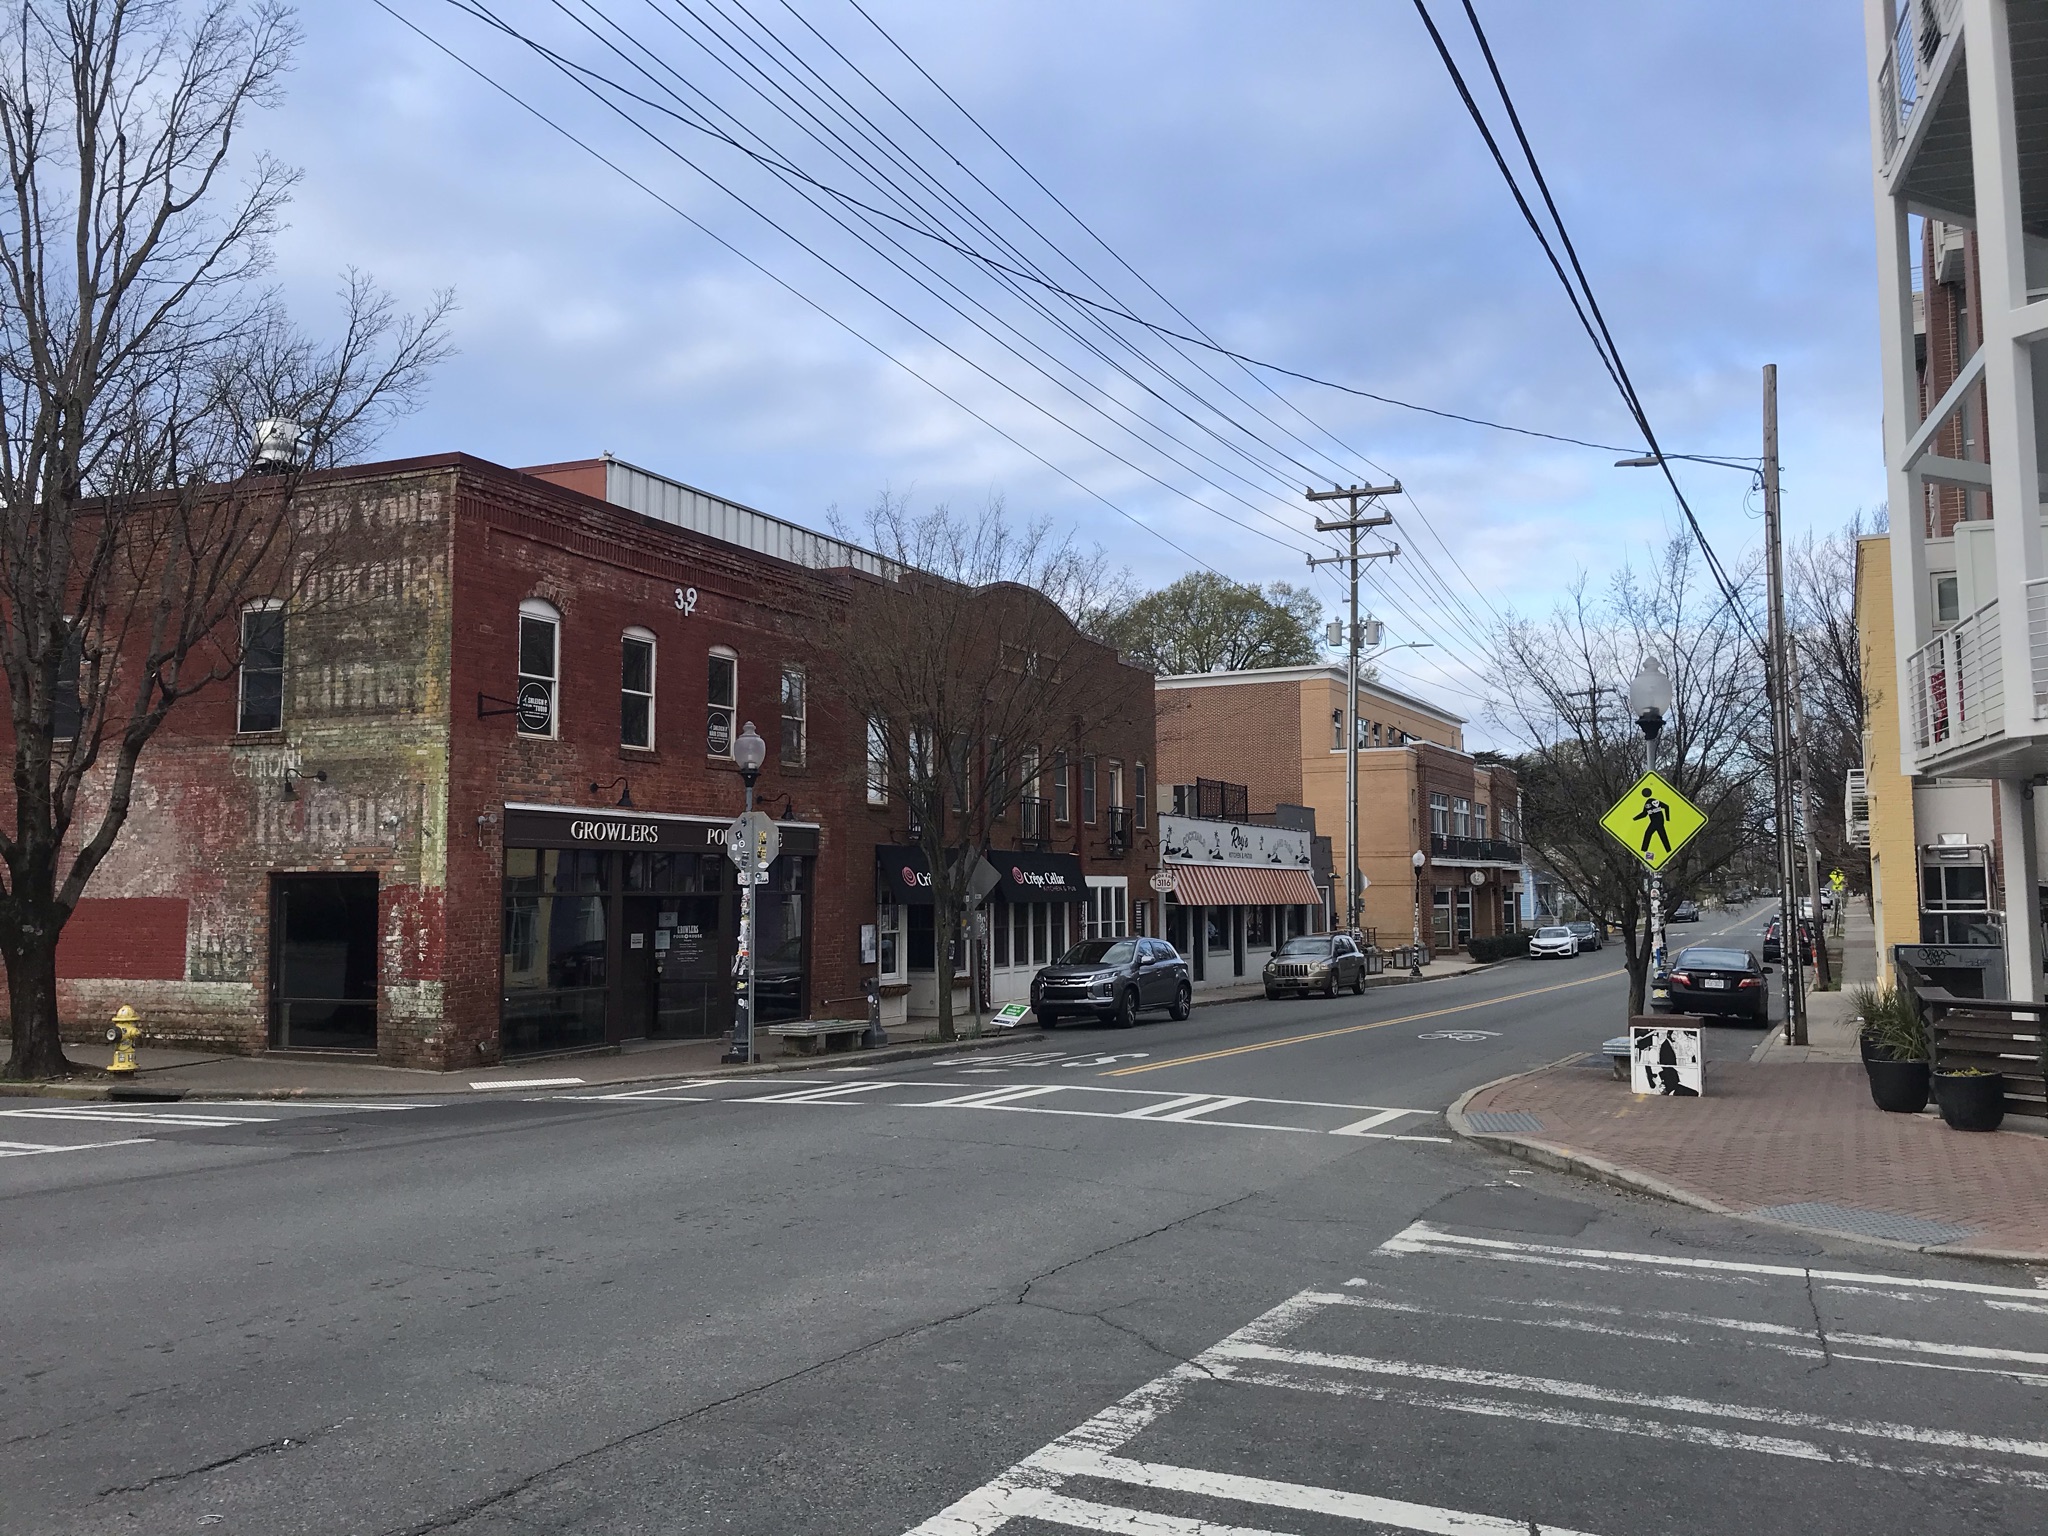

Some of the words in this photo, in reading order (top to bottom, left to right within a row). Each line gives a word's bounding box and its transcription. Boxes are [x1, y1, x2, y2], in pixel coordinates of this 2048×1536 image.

[570, 820, 659, 843] GROWLERS
[1023, 871, 1045, 888] Crêpe
[1048, 871, 1065, 885] Cellar
[1157, 879, 1171, 887] 3116
